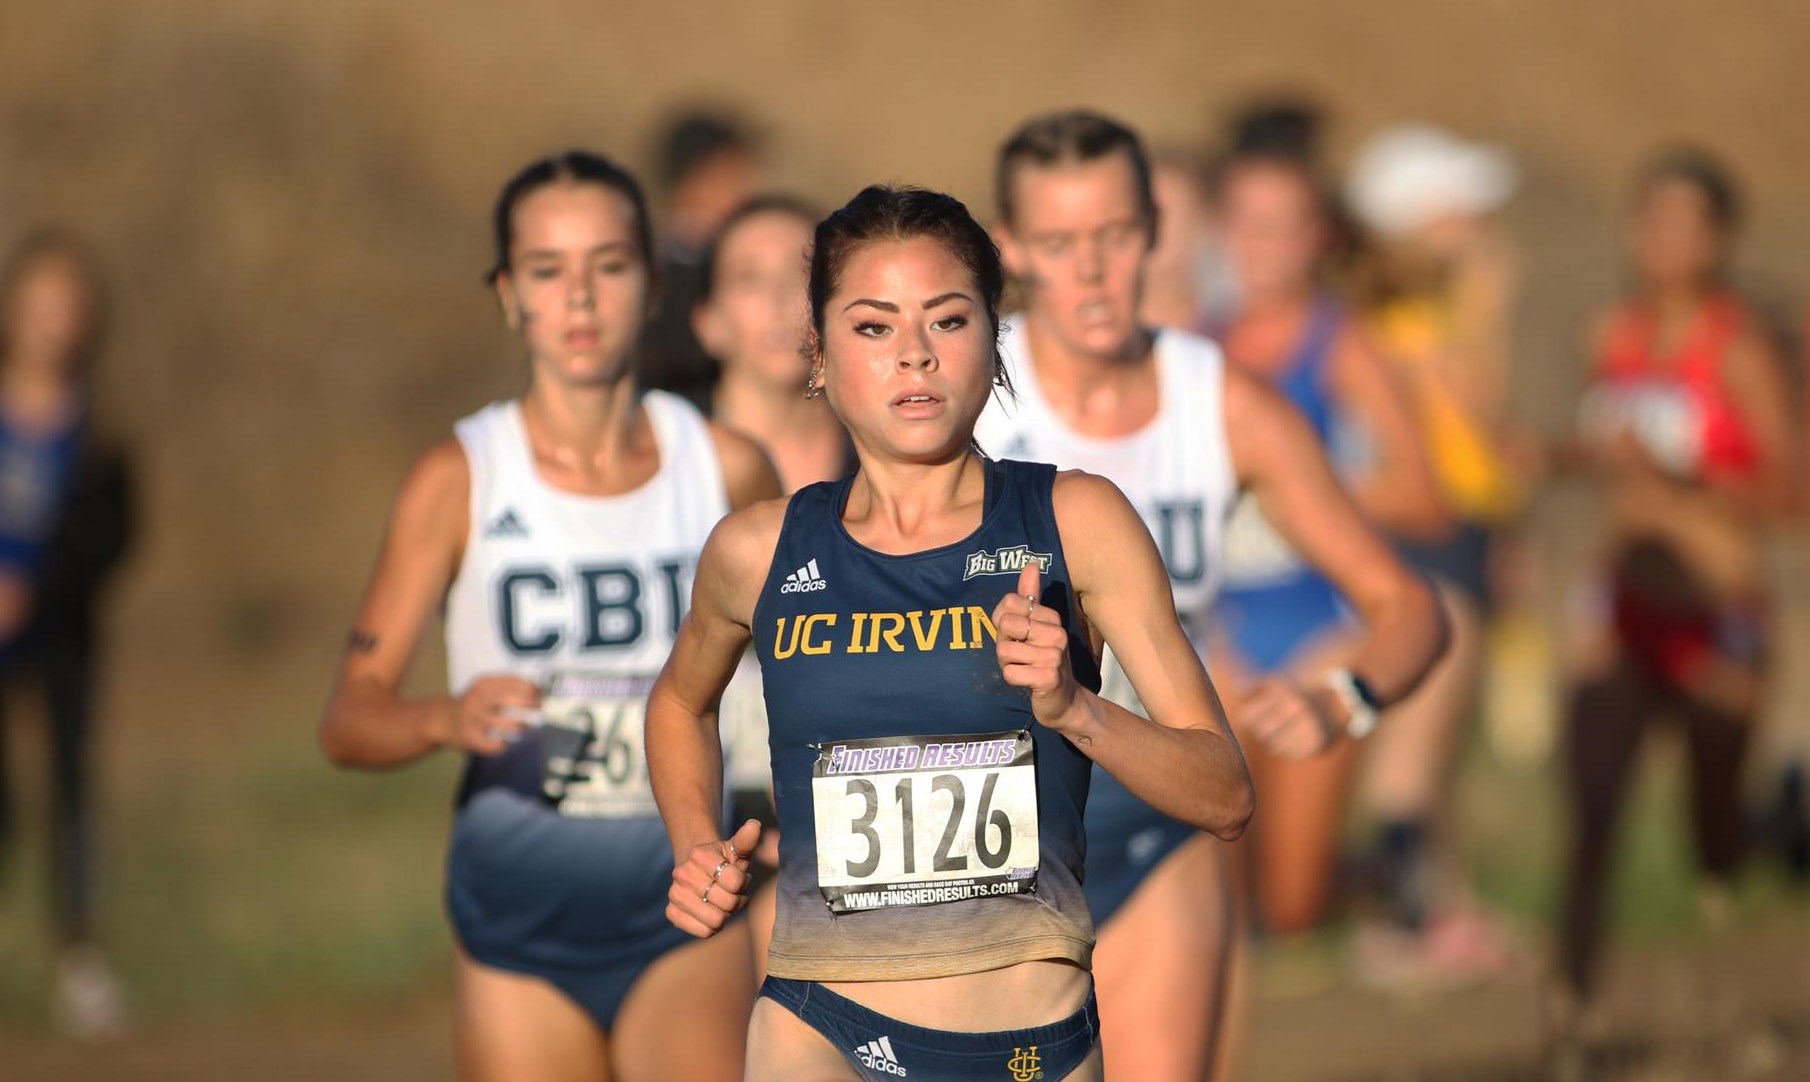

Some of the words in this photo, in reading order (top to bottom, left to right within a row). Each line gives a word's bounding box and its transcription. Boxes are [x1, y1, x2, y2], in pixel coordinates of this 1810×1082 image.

[968, 553, 995, 576] BIG
[780, 578, 827, 594] adidas
[773, 613, 837, 660] UC
[846, 606, 998, 654] IRVIN
[828, 745, 919, 774] FINISHED
[922, 740, 1016, 768] RESULTS
[846, 773, 1012, 878] 3126
[843, 881, 1019, 908] WWW.FINISHEDRESULTS.COM
[854, 1050, 907, 1078] didas
